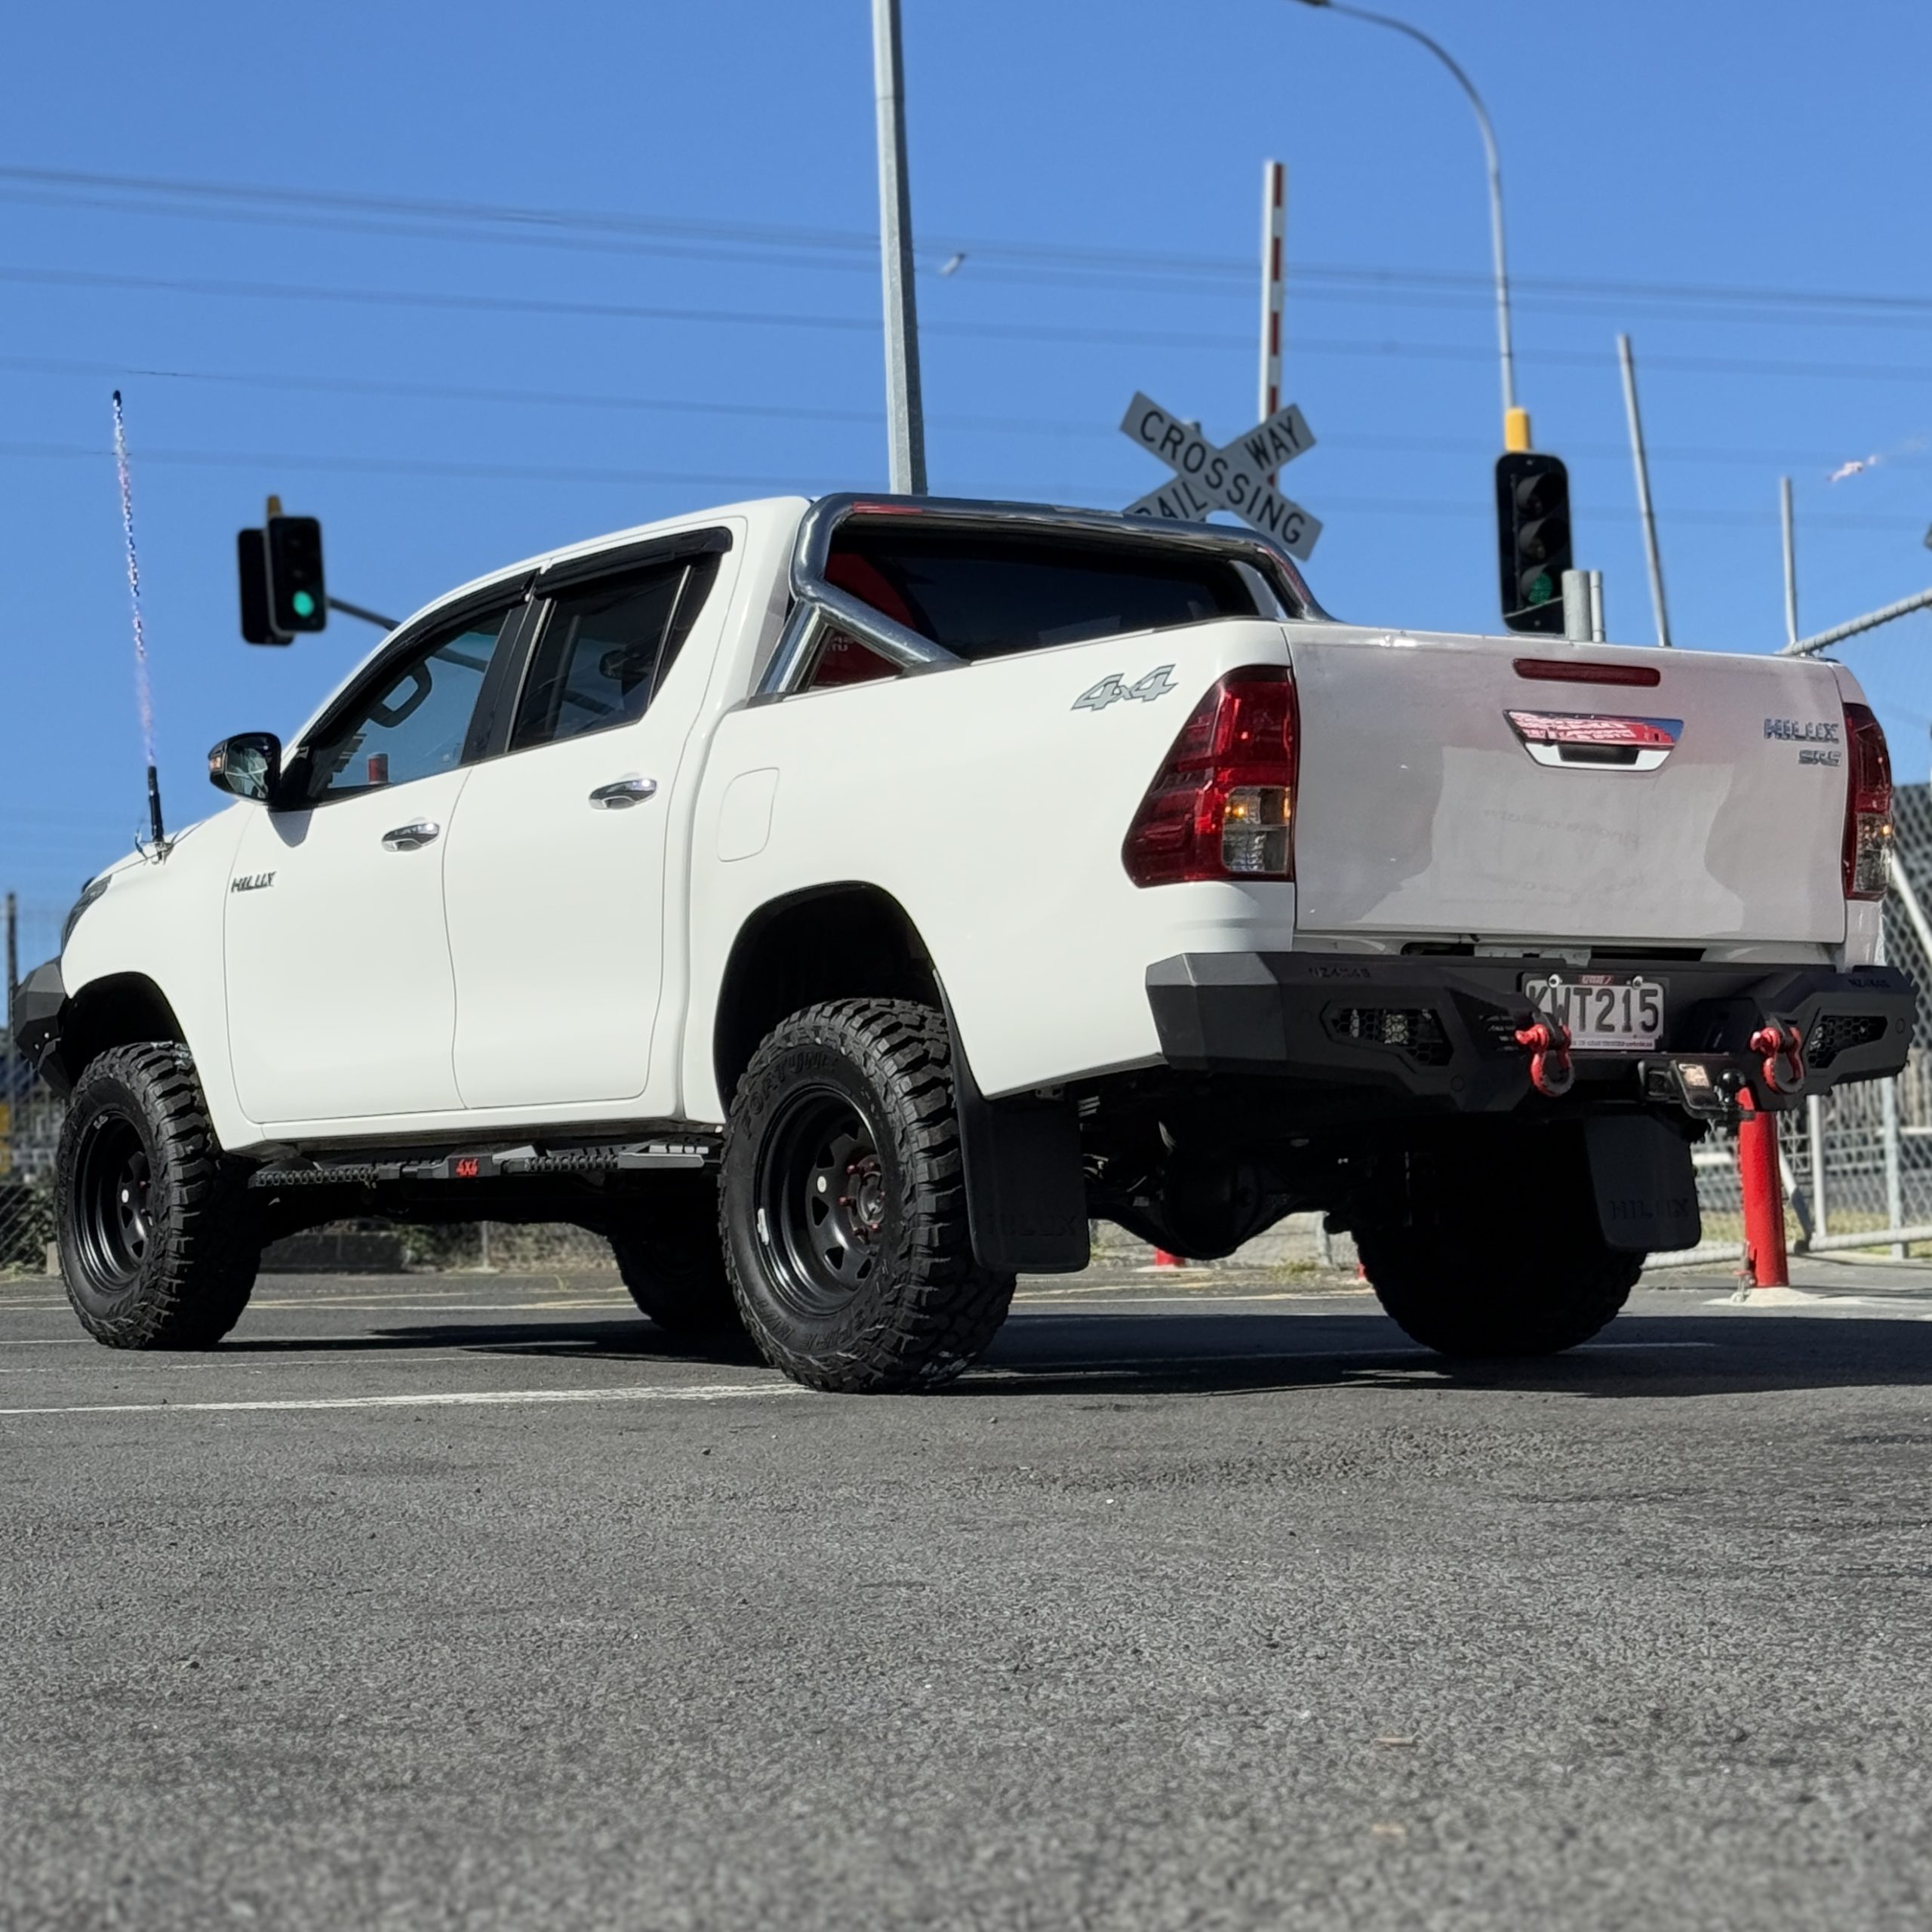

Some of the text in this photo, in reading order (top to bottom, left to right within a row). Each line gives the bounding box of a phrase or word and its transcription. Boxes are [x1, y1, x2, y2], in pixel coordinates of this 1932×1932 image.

[1134, 414, 1300, 518] AIL WAY
[1140, 410, 1306, 545] CROSSING
[1764, 718, 1840, 744] HILUX
[230, 870, 277, 894] HILUX
